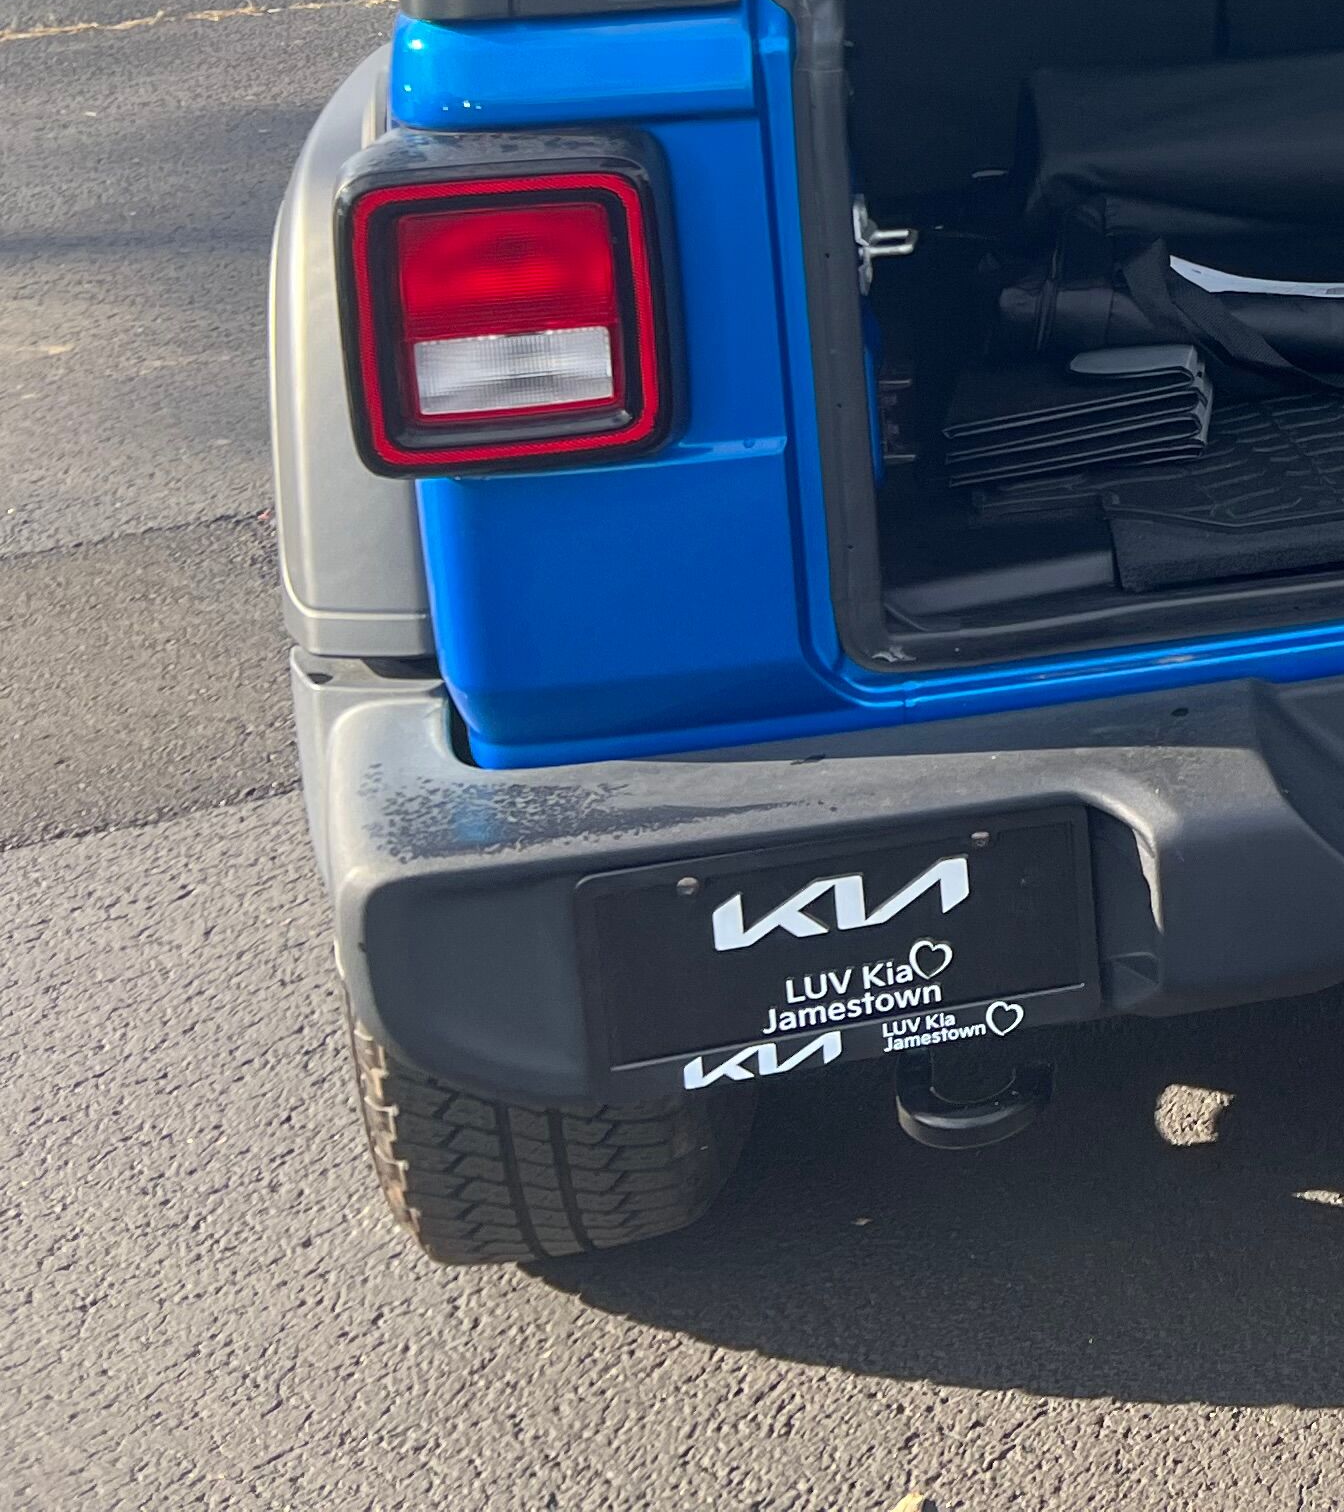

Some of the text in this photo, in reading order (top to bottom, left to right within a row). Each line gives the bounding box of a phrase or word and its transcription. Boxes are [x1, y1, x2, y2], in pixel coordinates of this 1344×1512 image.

[785, 960, 914, 1004] LUV Kia
[762, 983, 942, 1035] Jamestown
[881, 1011, 956, 1039] LUV Kia
[883, 1021, 987, 1053] Jamestown
